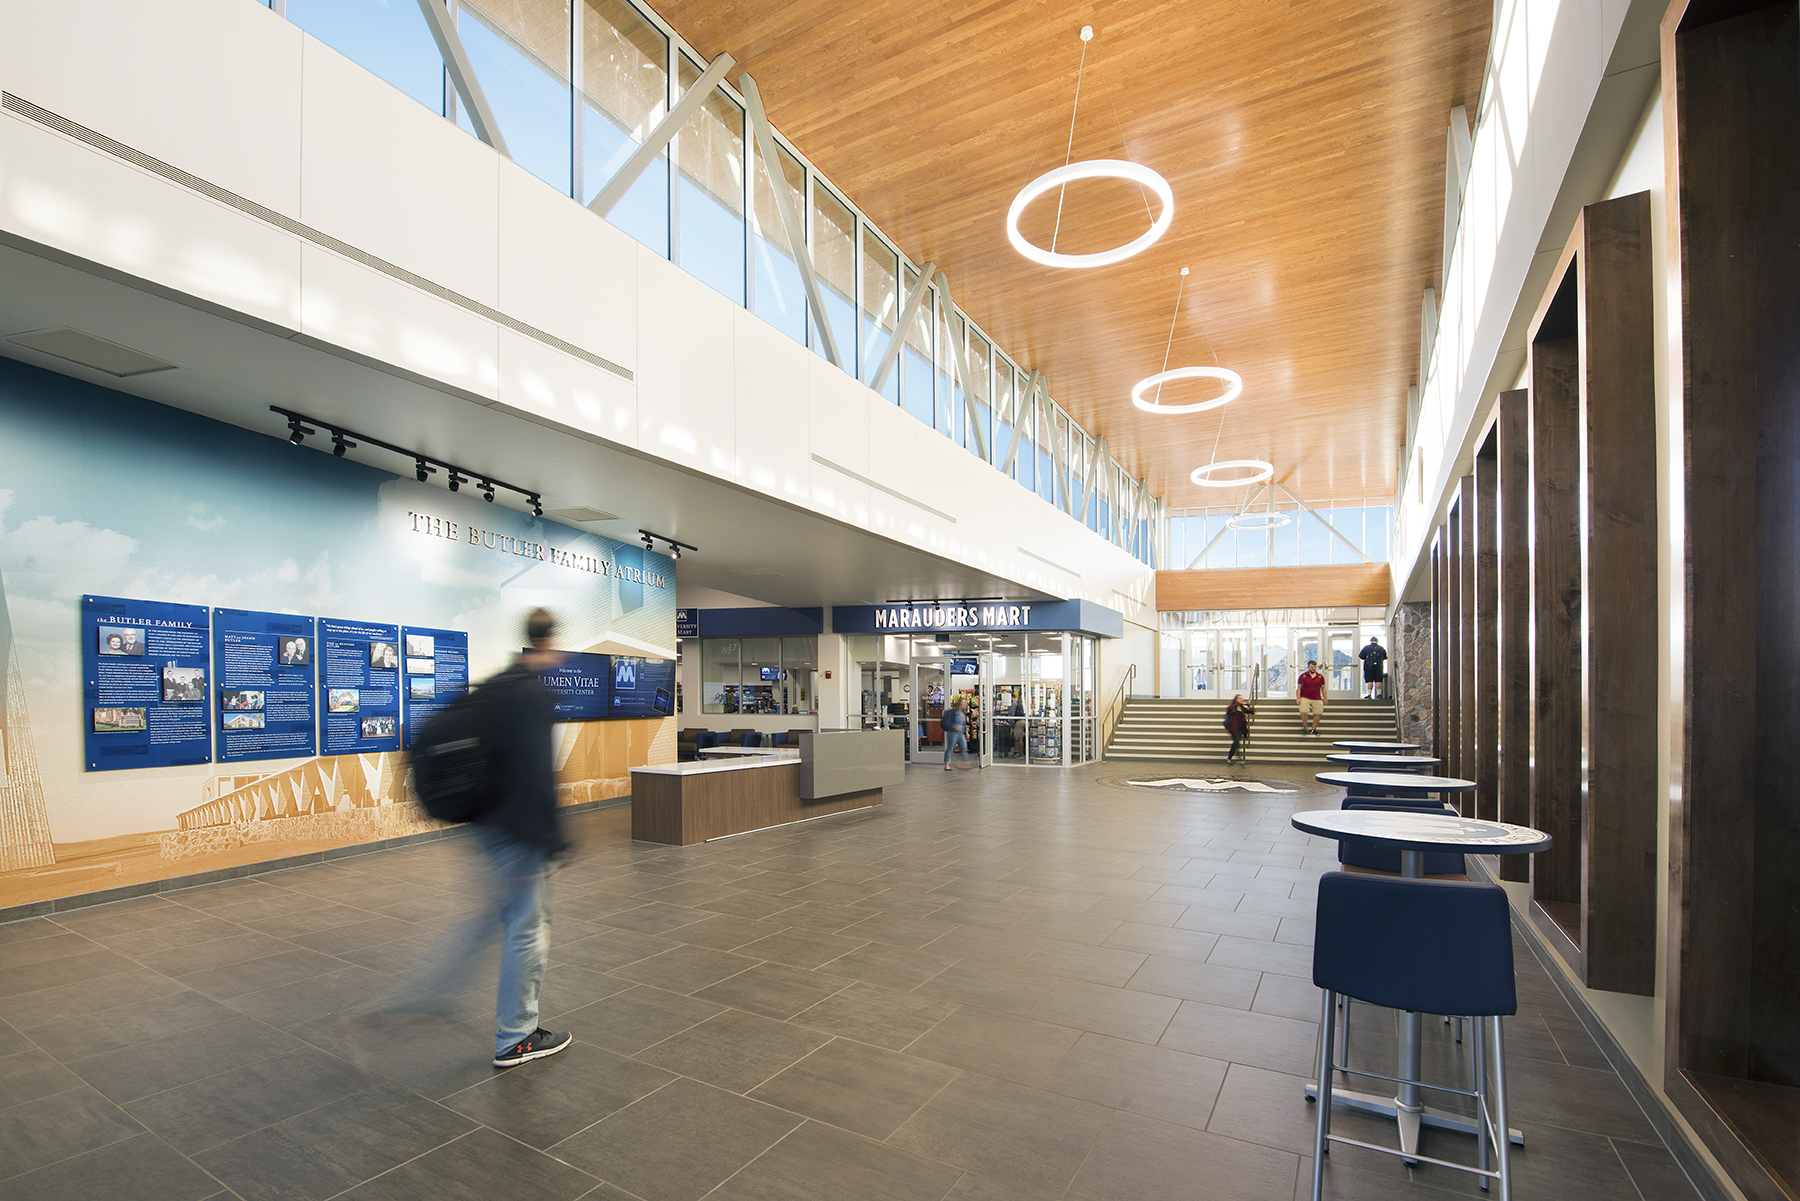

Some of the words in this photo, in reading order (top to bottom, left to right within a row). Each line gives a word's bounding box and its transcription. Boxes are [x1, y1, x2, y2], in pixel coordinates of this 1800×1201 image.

[408, 511, 460, 541] THE
[468, 526, 546, 562] BUTLER
[550, 546, 611, 577] FAMILY
[615, 564, 666, 589] ATRIUM
[109, 616, 152, 626] BUTLER
[155, 619, 193, 629] FAMILY
[875, 606, 979, 628] MARAUDERS
[983, 605, 1031, 627] MART
[573, 676, 600, 688] VITAE
